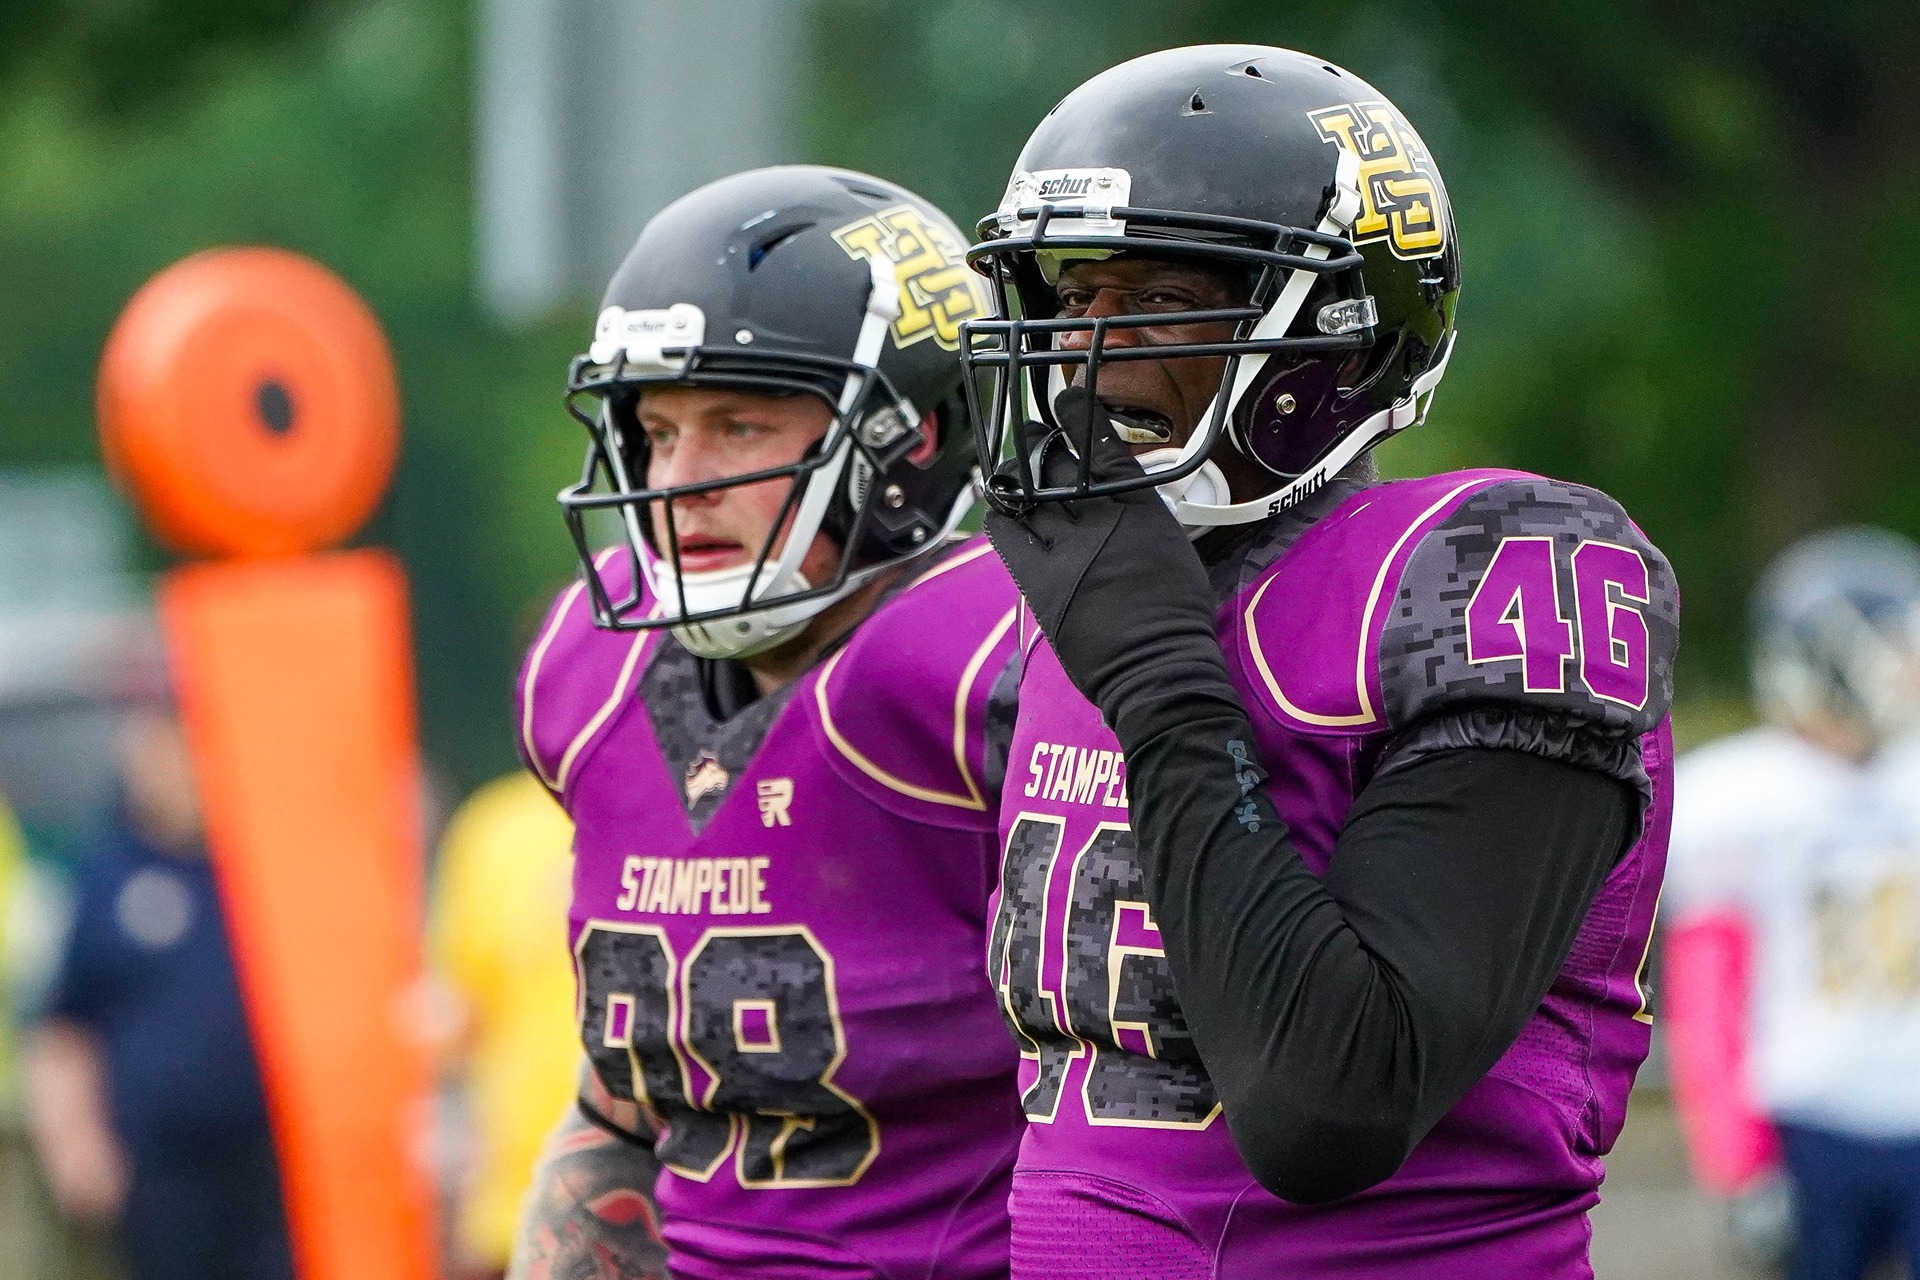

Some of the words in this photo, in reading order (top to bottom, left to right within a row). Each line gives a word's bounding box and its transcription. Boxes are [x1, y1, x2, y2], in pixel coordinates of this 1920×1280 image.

[1039, 174, 1092, 196] schut
[1267, 466, 1327, 517] schutt
[1464, 536, 1650, 711] 46
[1024, 741, 1129, 808] STAMPE
[616, 855, 772, 915] STAMPEDE
